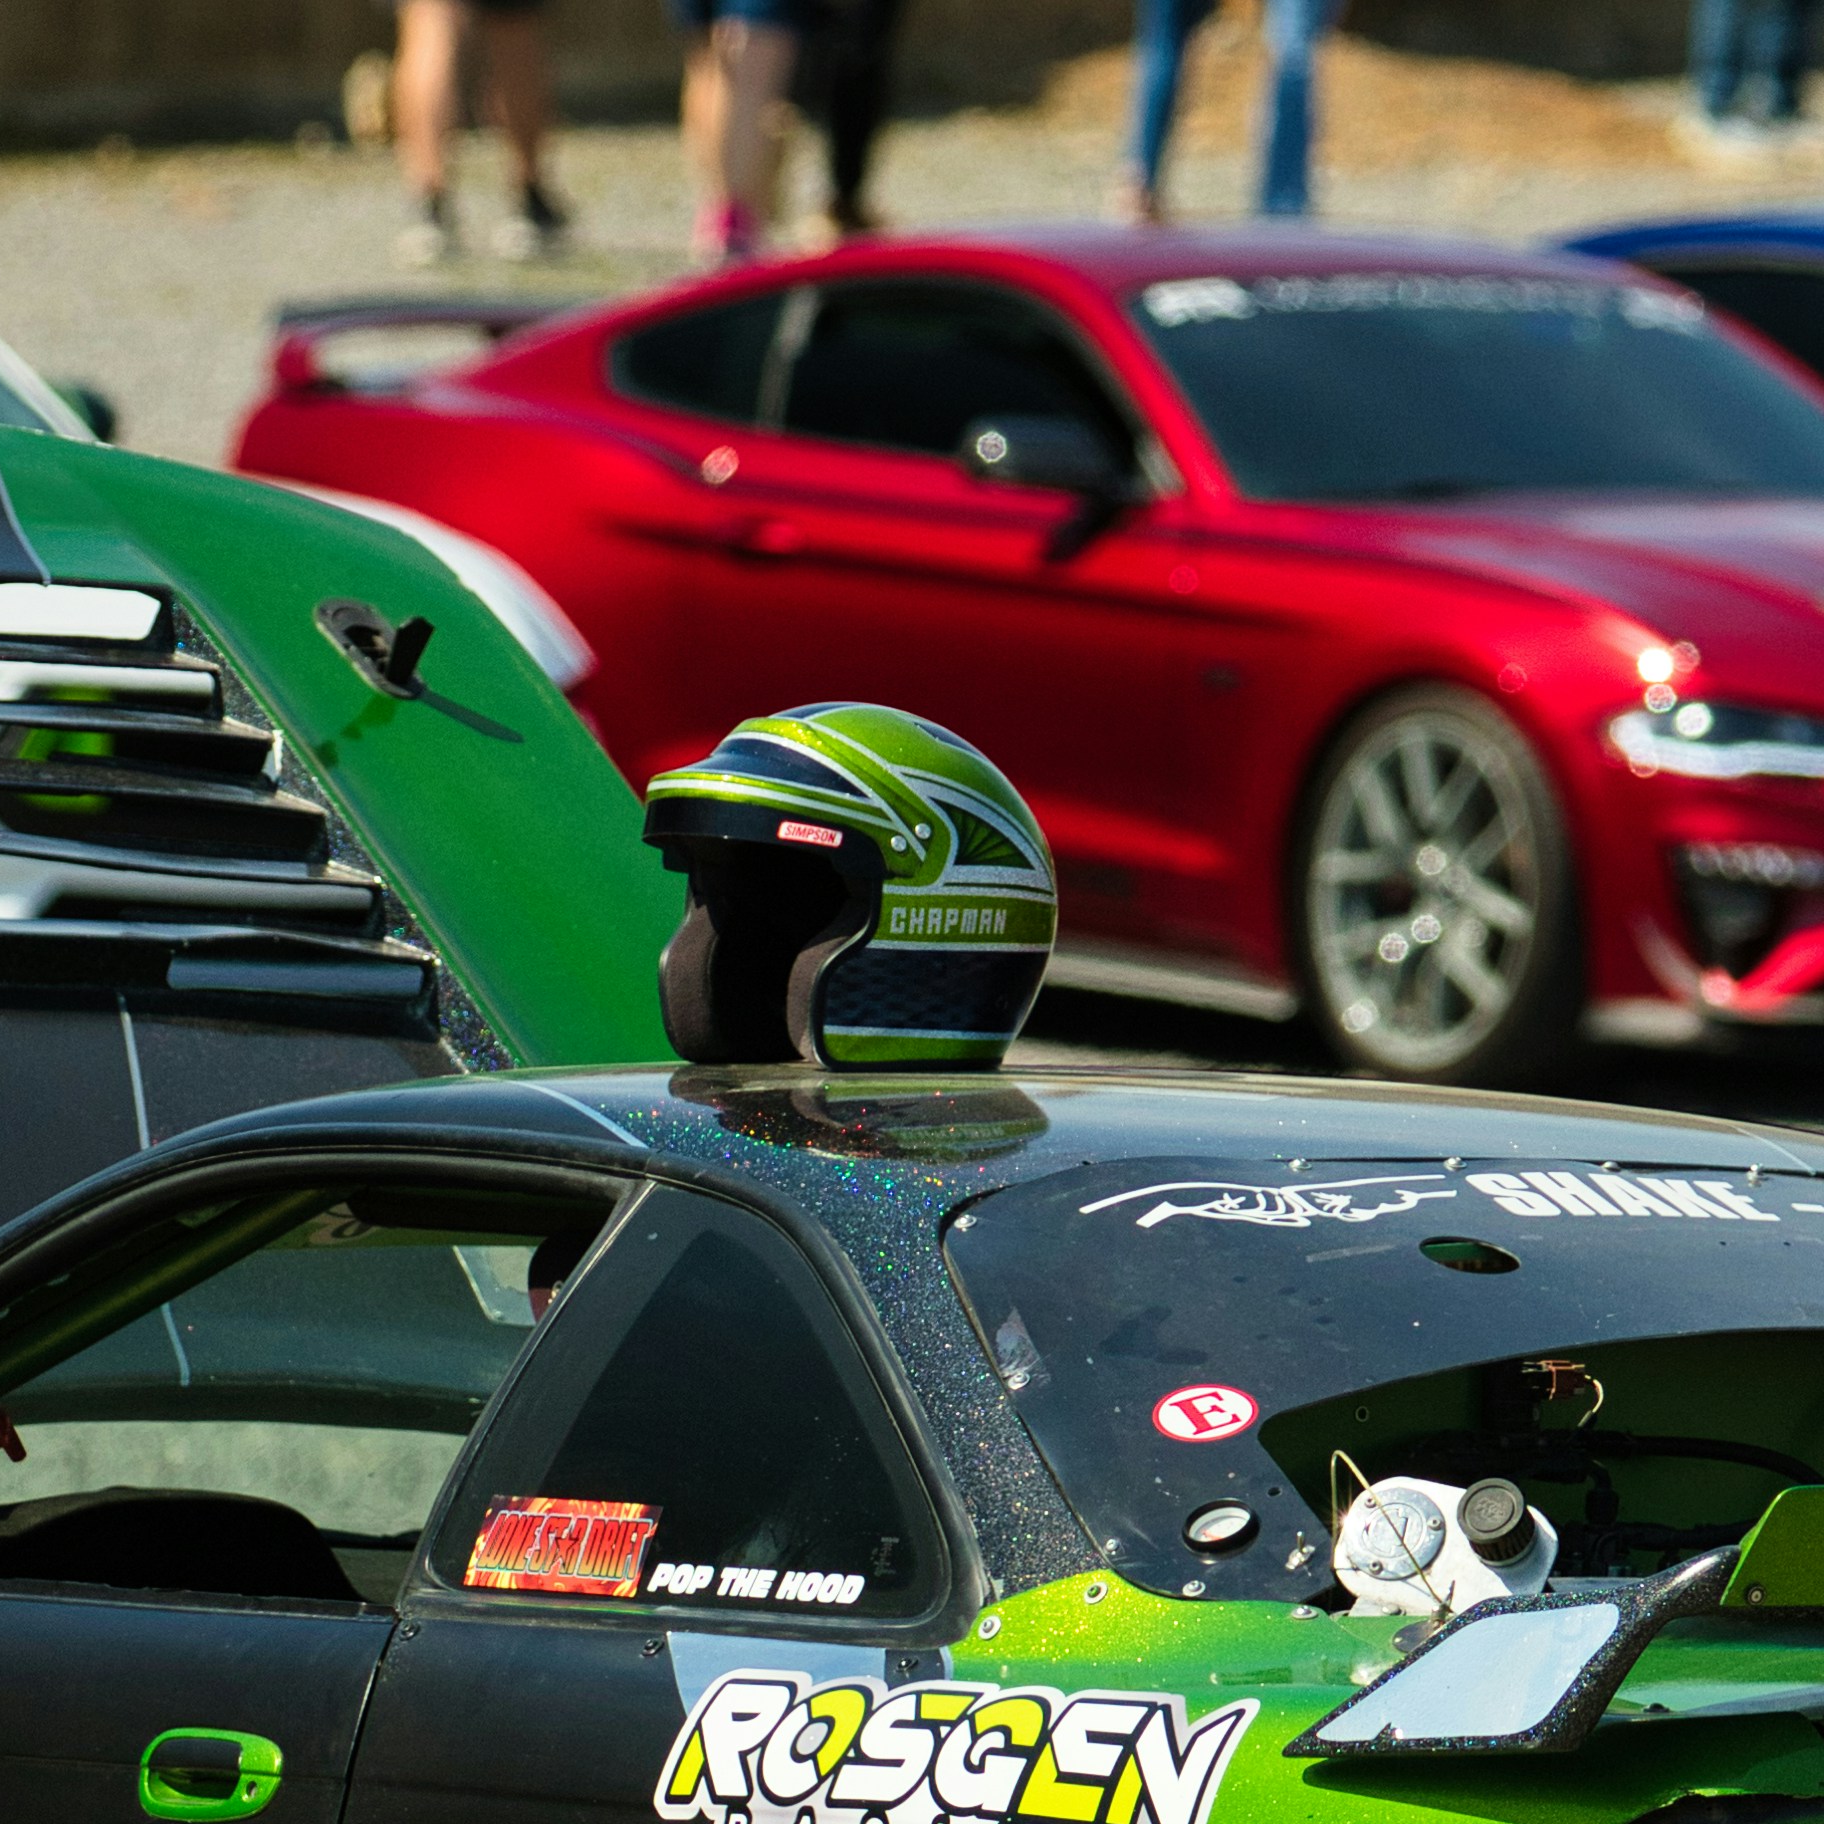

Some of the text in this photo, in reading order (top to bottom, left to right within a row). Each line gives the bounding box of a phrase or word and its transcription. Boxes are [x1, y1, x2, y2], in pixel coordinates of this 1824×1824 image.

[783, 823, 837, 846] SIMPSON
[889, 906, 1007, 936] CHAPMAN
[1465, 1171, 1781, 1222] SHAKE
[1169, 1390, 1242, 1436] E
[476, 1511, 546, 1571] LONE
[576, 1518, 651, 1580] DRIFT
[647, 1562, 866, 1604] POP THE HOOD
